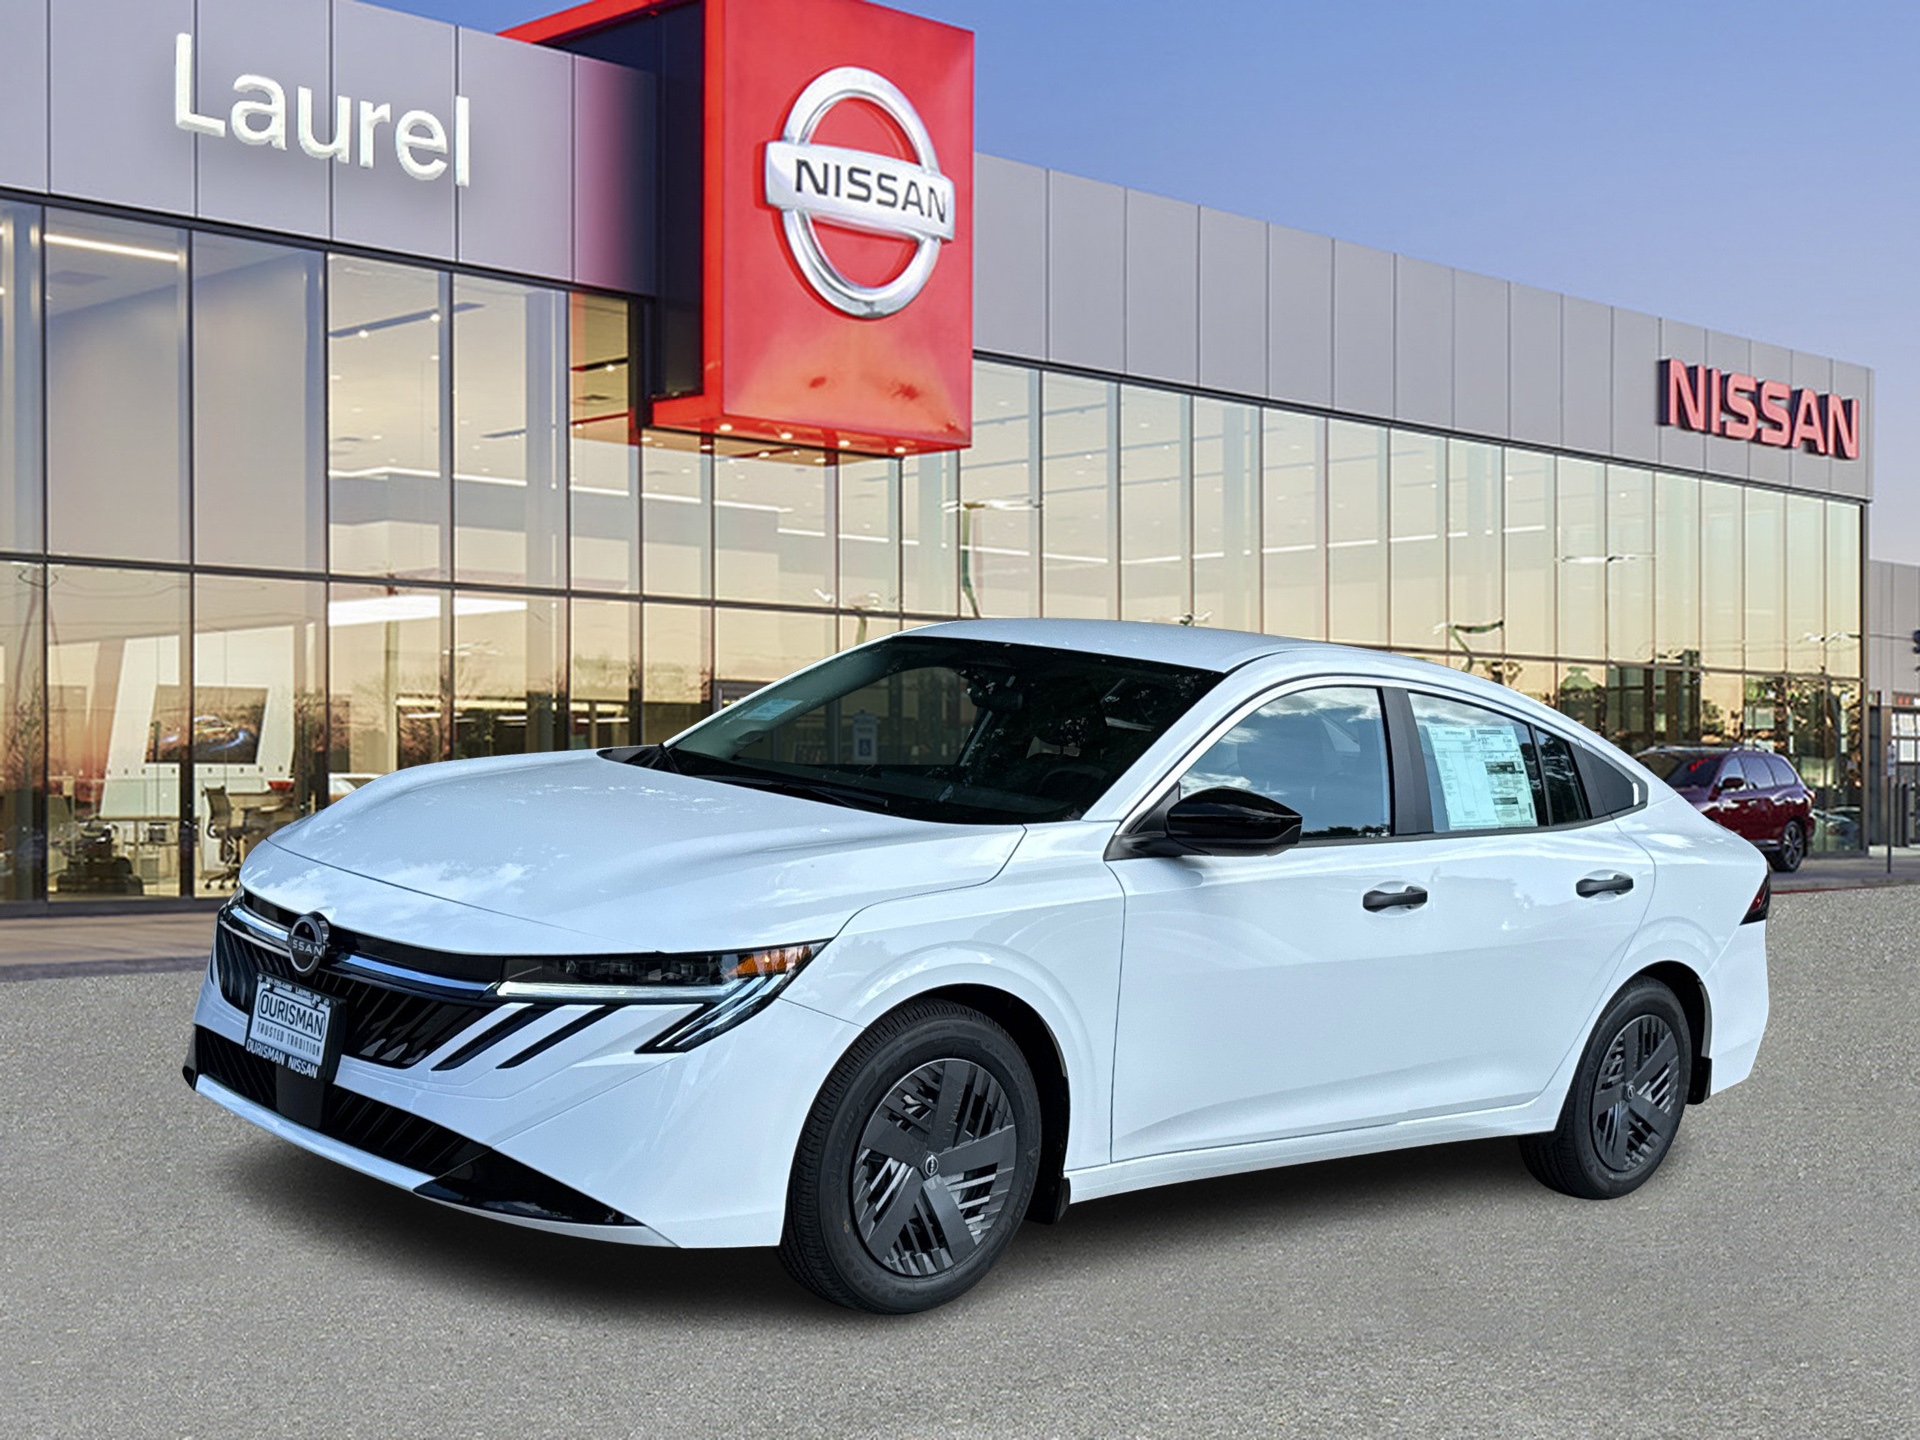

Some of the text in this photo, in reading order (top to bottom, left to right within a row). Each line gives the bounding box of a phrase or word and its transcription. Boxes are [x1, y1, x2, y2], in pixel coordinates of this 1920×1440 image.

[175, 33, 470, 187] Laurel
[795, 158, 948, 224] NISSAN
[1659, 358, 1860, 459] NISSAN
[292, 938, 323, 956] SSAN
[260, 994, 324, 1036] OURISMAN
[245, 1038, 319, 1079] OURISMAN NISSAN
[257, 1021, 321, 1057] TRUSTED TRADITION
